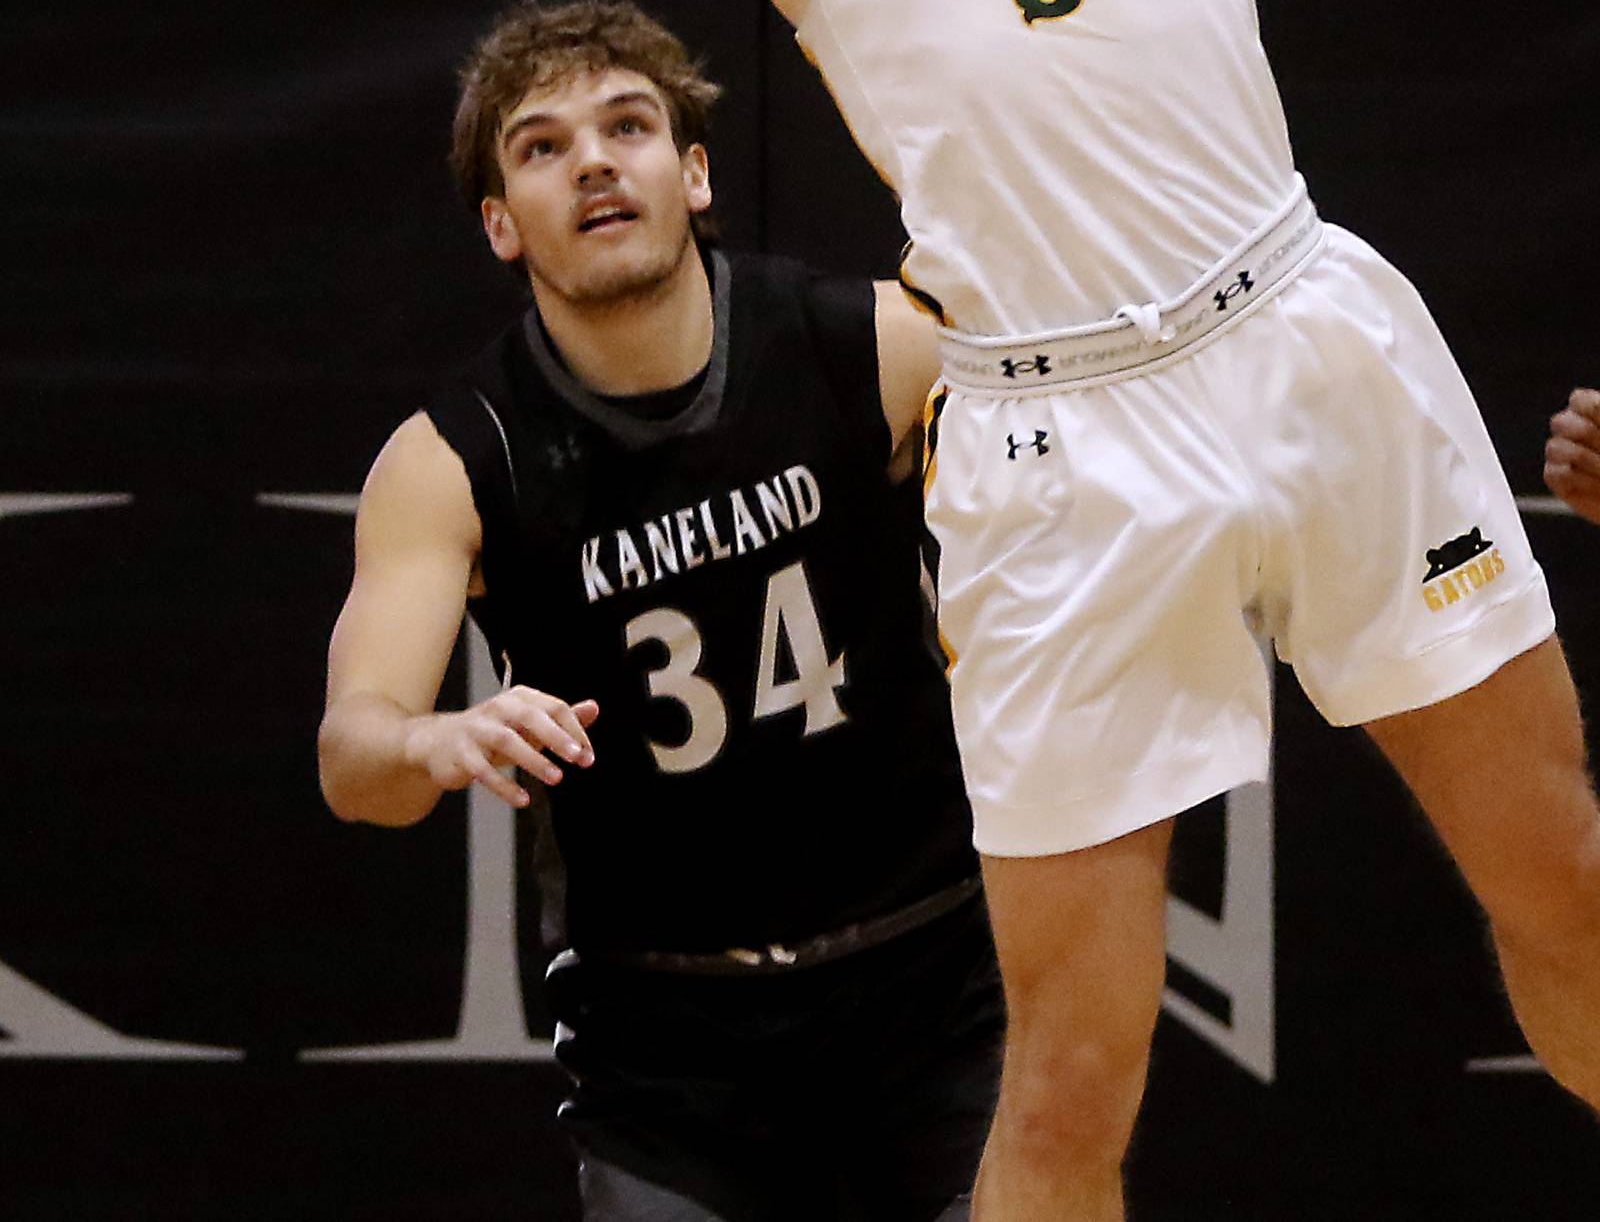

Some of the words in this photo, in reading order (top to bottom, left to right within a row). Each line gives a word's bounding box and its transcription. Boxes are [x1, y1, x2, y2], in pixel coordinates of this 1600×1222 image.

[581, 464, 822, 604] KANELAND
[1422, 547, 1506, 613] GATORS
[624, 561, 849, 774] 34
